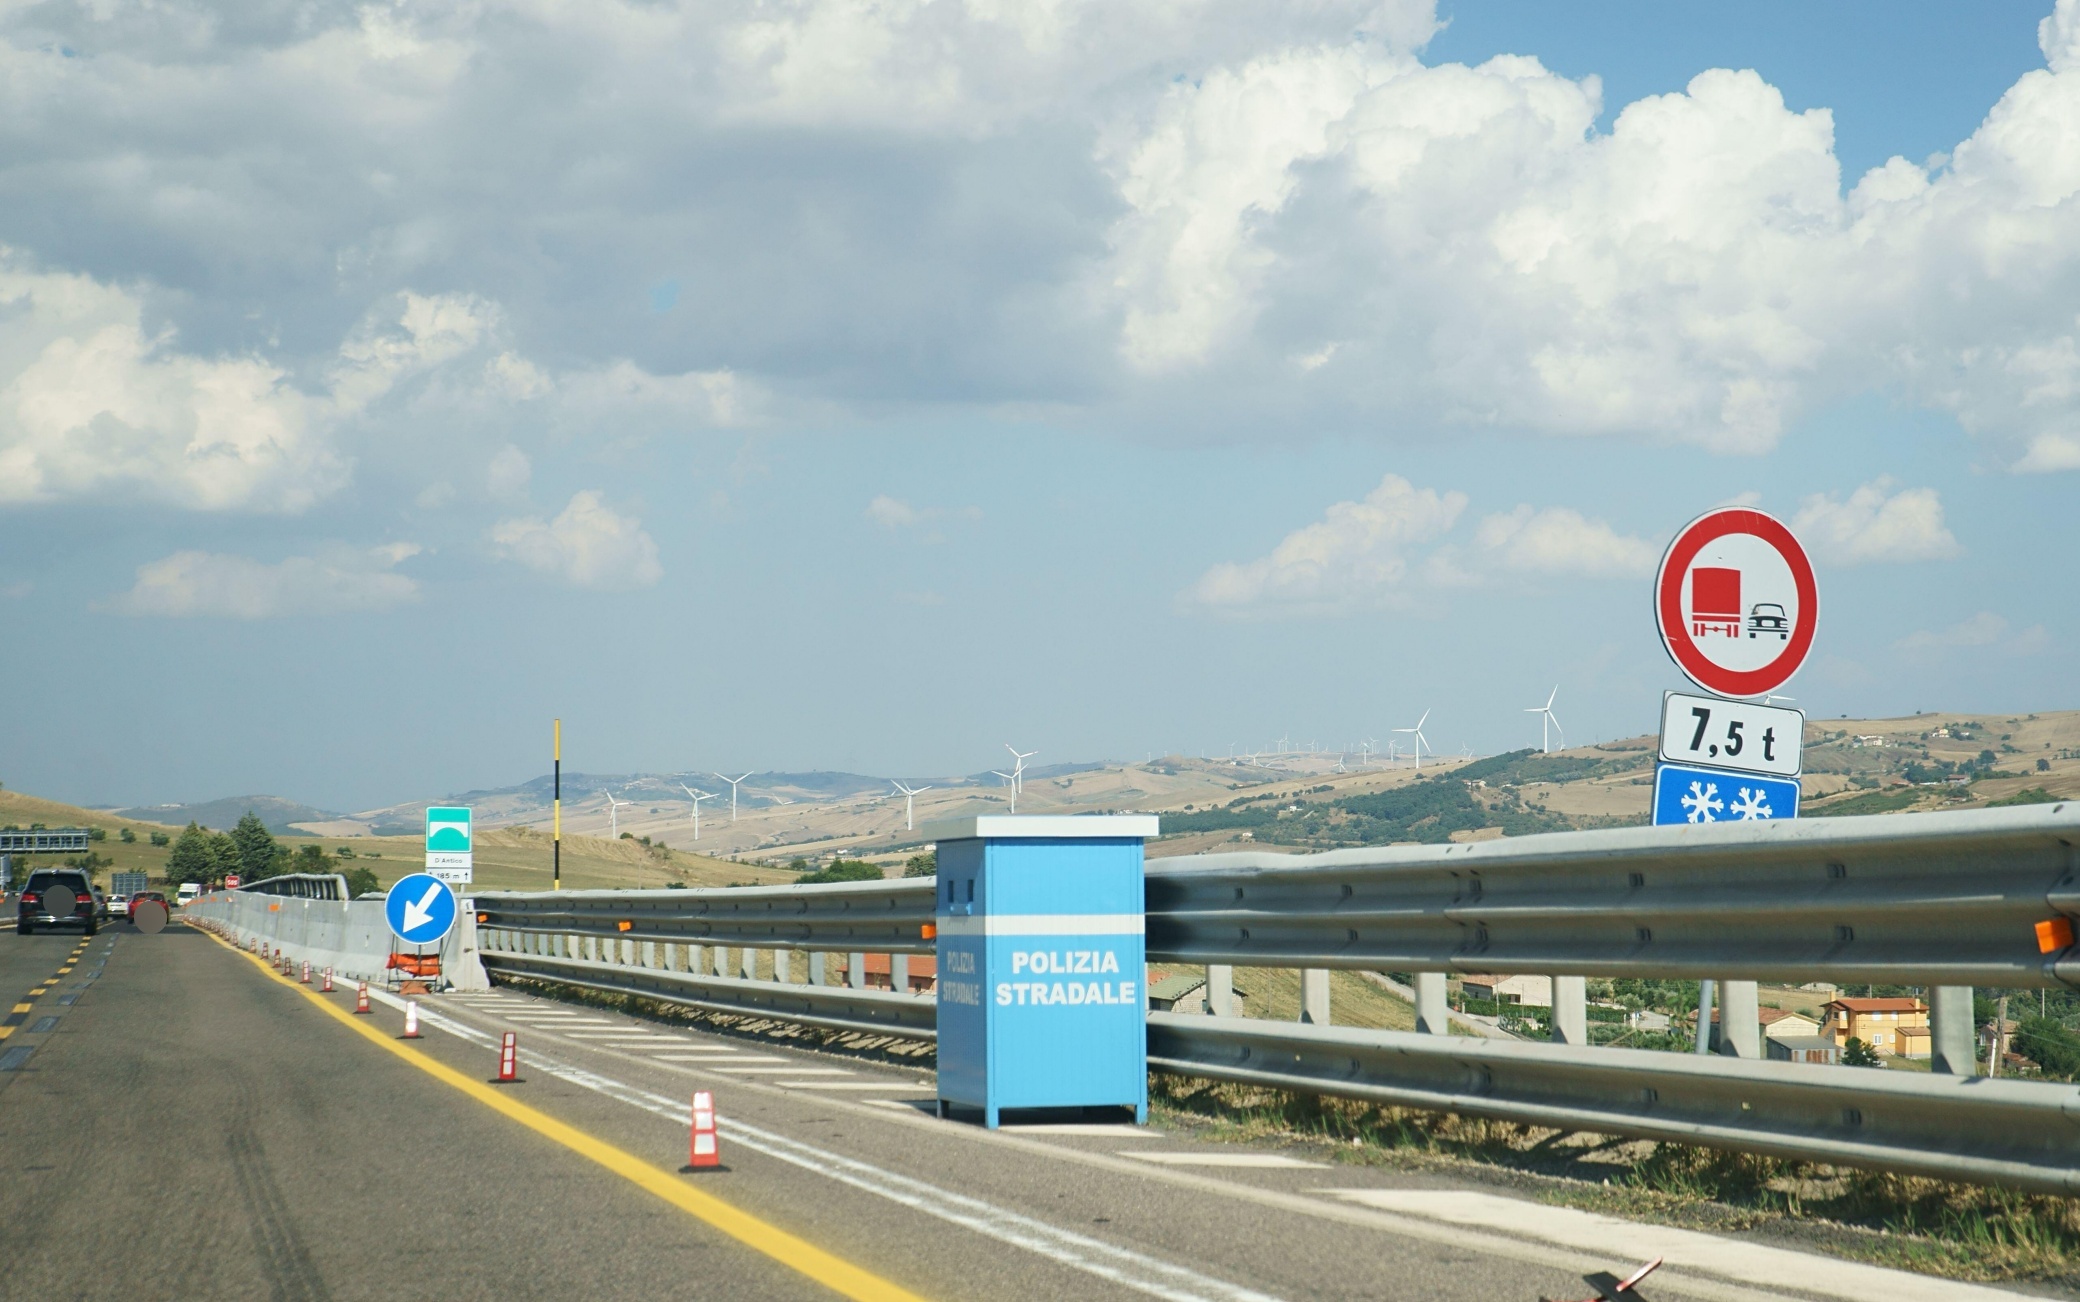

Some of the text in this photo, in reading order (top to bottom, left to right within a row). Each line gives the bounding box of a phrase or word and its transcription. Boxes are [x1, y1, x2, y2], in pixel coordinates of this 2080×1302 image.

[1689, 706, 1775, 762] 7,5 t
[947, 951, 976, 975] POLIZIA
[1011, 951, 1119, 974] POLIZIA
[942, 981, 980, 1006] STRADALE
[996, 981, 1136, 1006] STRADALE
